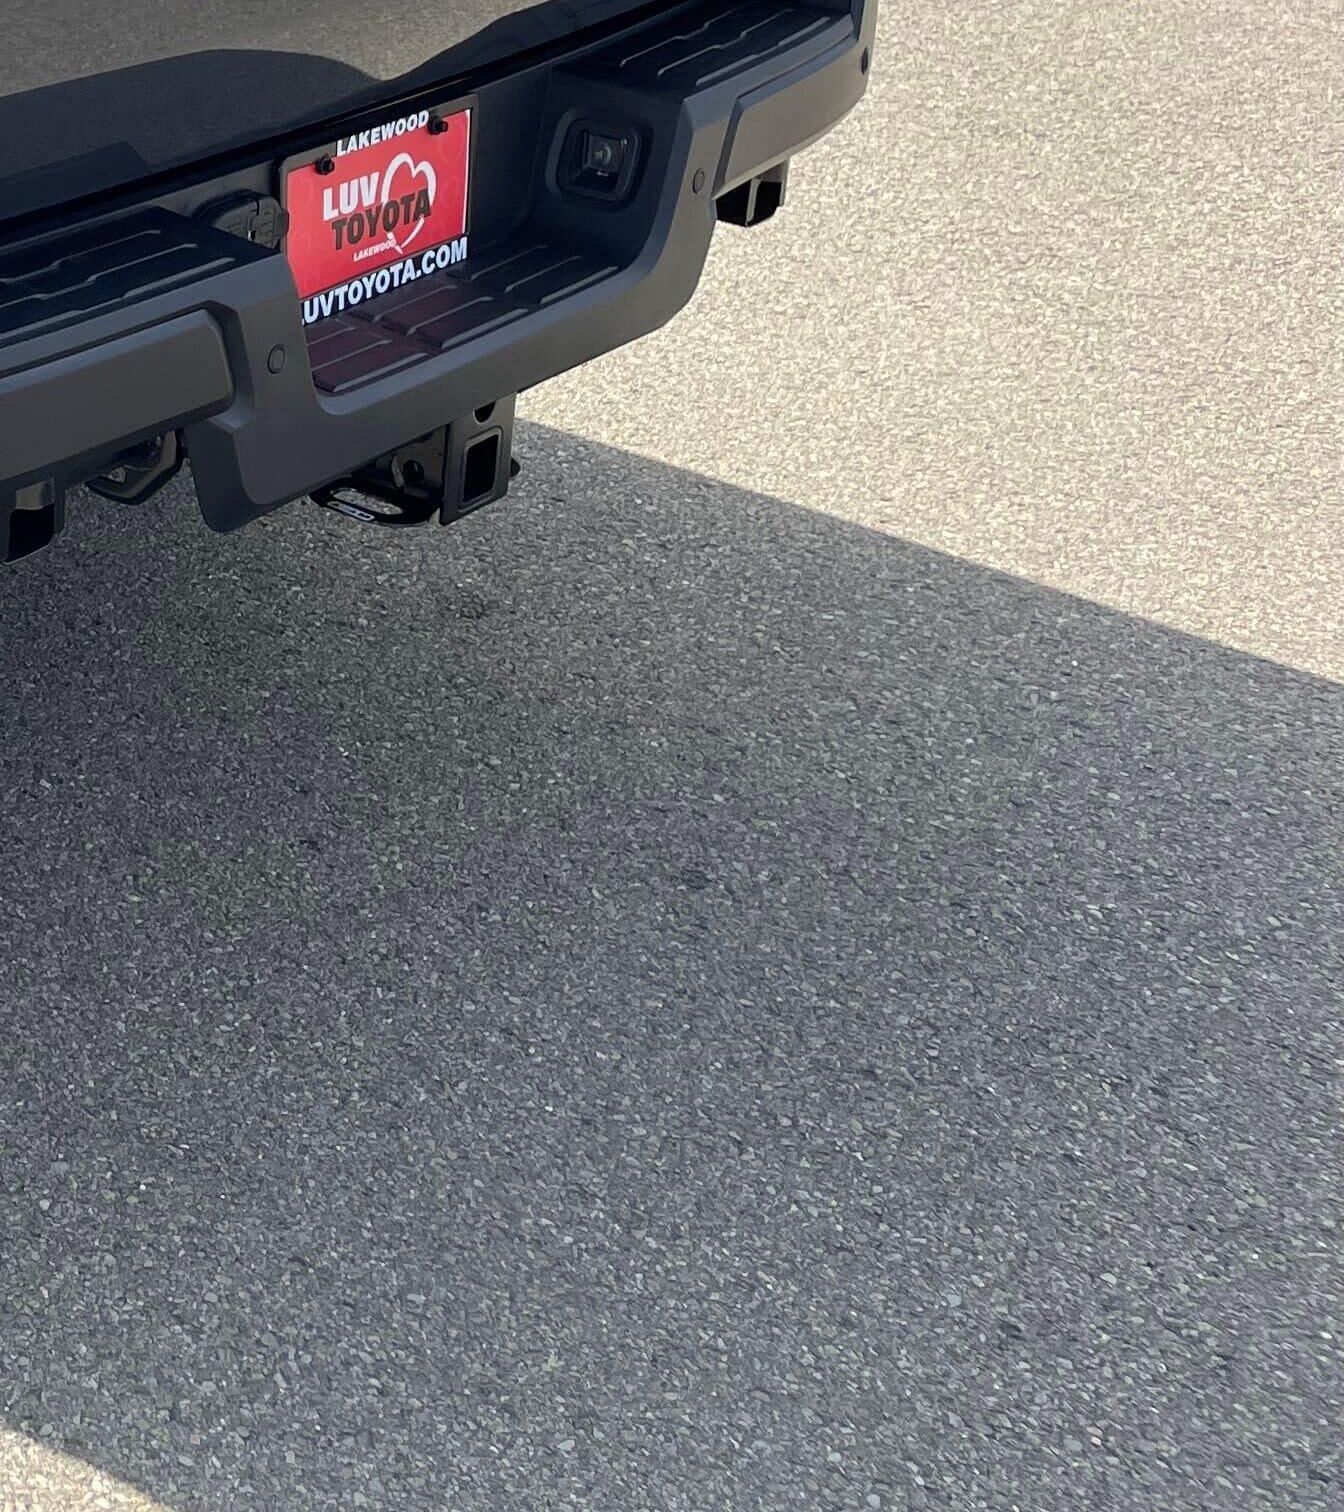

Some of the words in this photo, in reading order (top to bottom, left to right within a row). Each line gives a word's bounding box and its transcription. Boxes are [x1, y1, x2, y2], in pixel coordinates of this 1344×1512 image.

[336, 109, 430, 157] LAKEWOOD
[323, 171, 381, 222] LUV
[332, 188, 432, 251] TOYOTA
[353, 238, 397, 262] LAKEWOOD
[301, 236, 468, 326] UVTOYOTA.COM
